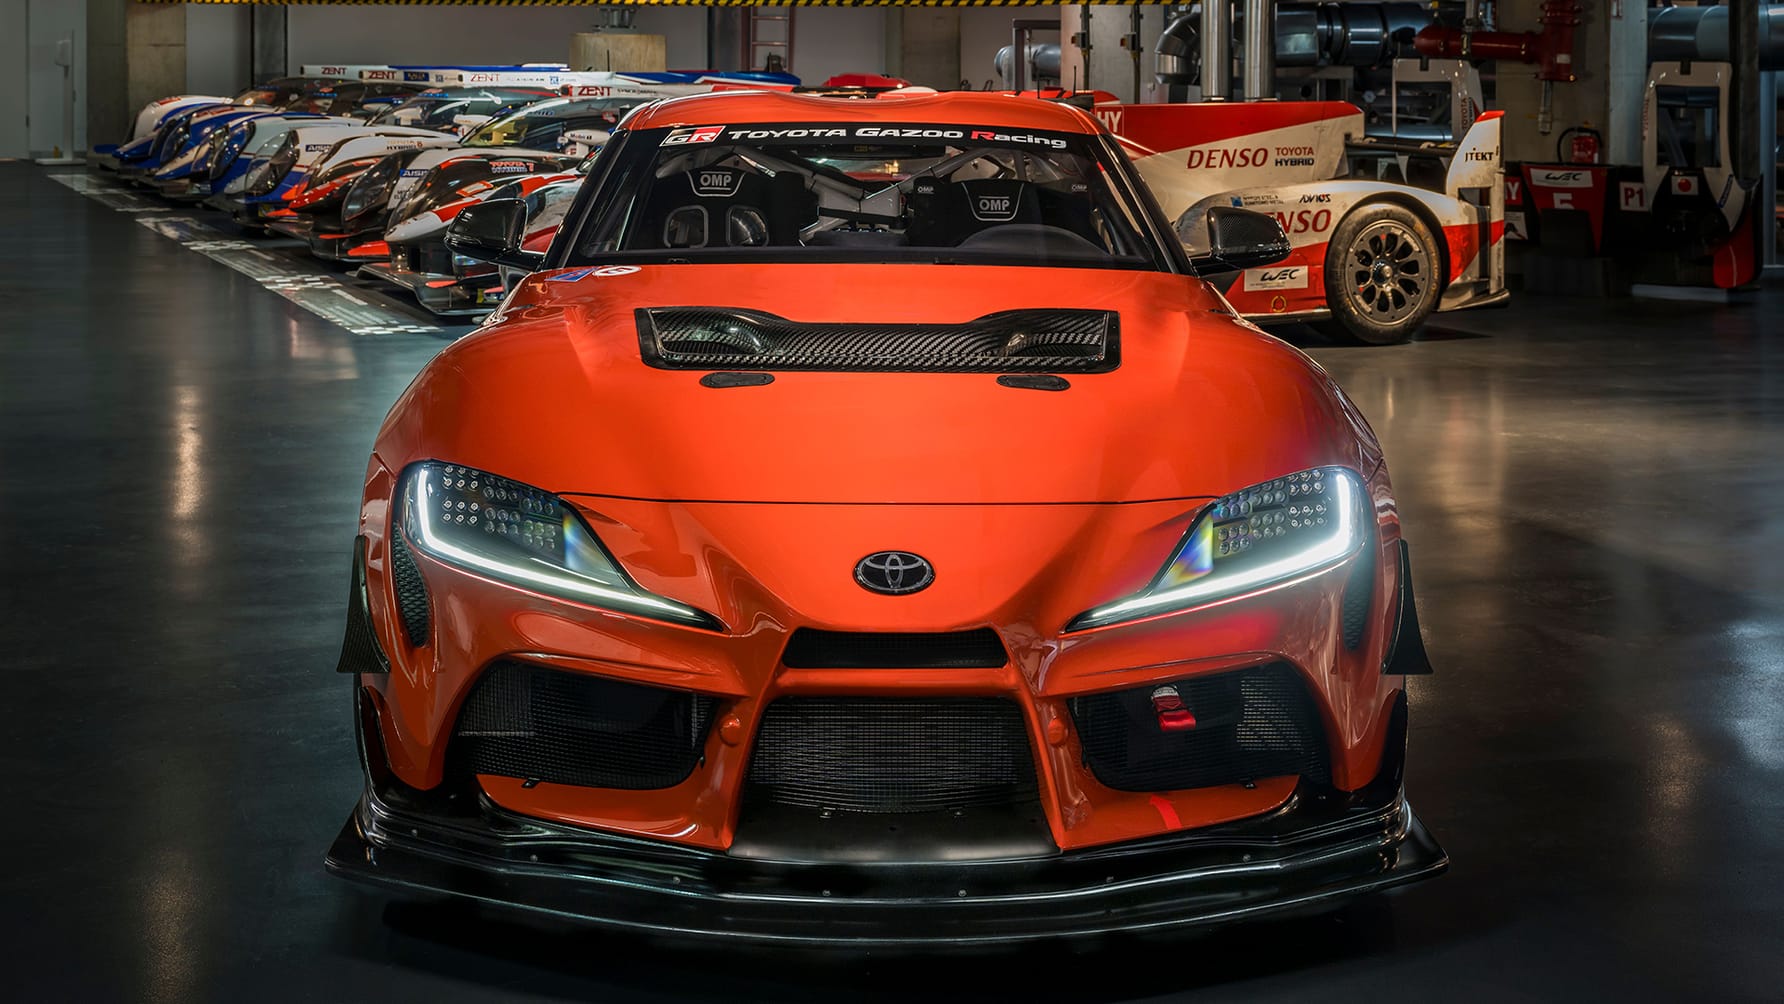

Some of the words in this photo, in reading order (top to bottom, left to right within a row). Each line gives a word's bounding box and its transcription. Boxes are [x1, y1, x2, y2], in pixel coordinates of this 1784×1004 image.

[321, 67, 347, 75] ZENT
[368, 70, 397, 80] ZENT
[470, 74, 500, 82] ZENT
[578, 86, 613, 97] ZENT
[1097, 111, 1122, 133] HY
[663, 130, 718, 145] GR
[728, 128, 847, 140] TOYOTA
[855, 127, 964, 138] GAZOO
[970, 130, 1067, 149] Racing
[1186, 147, 1269, 169] DENSO
[1275, 147, 1315, 157] TOYOTA
[1464, 149, 1495, 162] JTEKT
[1275, 157, 1315, 167] HYBRID
[700, 174, 732, 187] OMP
[1545, 172, 1583, 181] WEC
[1624, 187, 1645, 207] P1
[979, 199, 1010, 212] OMP
[1264, 209, 1332, 234] NSO
[1260, 269, 1300, 282] WEC
